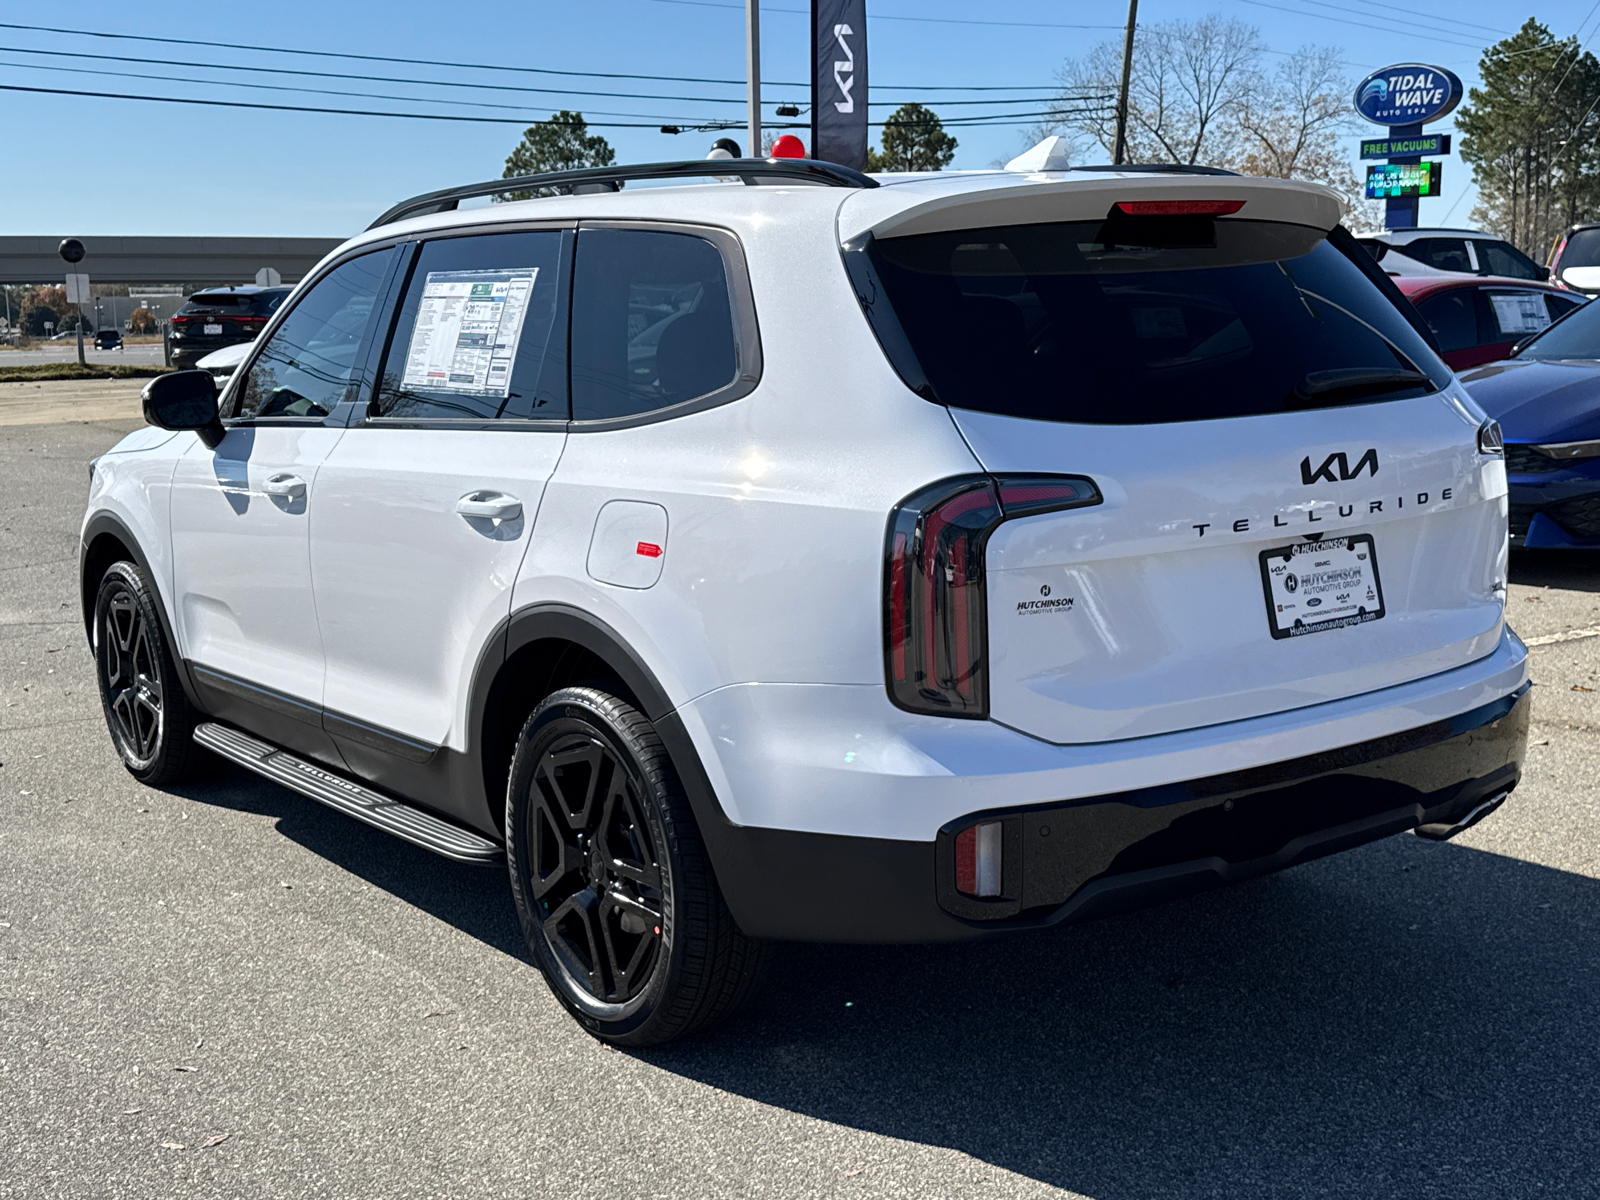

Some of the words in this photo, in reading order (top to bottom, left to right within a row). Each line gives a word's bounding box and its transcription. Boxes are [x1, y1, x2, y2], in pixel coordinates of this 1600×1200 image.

[834, 24, 854, 113] KIA
[1388, 73, 1434, 91] TIDAL
[1395, 88, 1443, 107] WAVE
[1375, 109, 1400, 117] AUTO
[1407, 107, 1426, 115] SPA
[1363, 142, 1388, 154] FREE
[1390, 138, 1437, 153] VACUUMS
[1300, 448, 1379, 486] KIA
[1192, 488, 1452, 538] TELLURIDE
[1300, 537, 1349, 554] HUTCHINSON
[1300, 566, 1362, 588] HUTCHINSON
[1303, 582, 1341, 595] AUTOMOTIVE
[1342, 579, 1361, 588] GROUP
[1017, 597, 1074, 610] HUTCHINSON
[1018, 607, 1053, 616] AUTOMOTIVE
[1290, 612, 1376, 637] Hutchinsonautogroup.com
